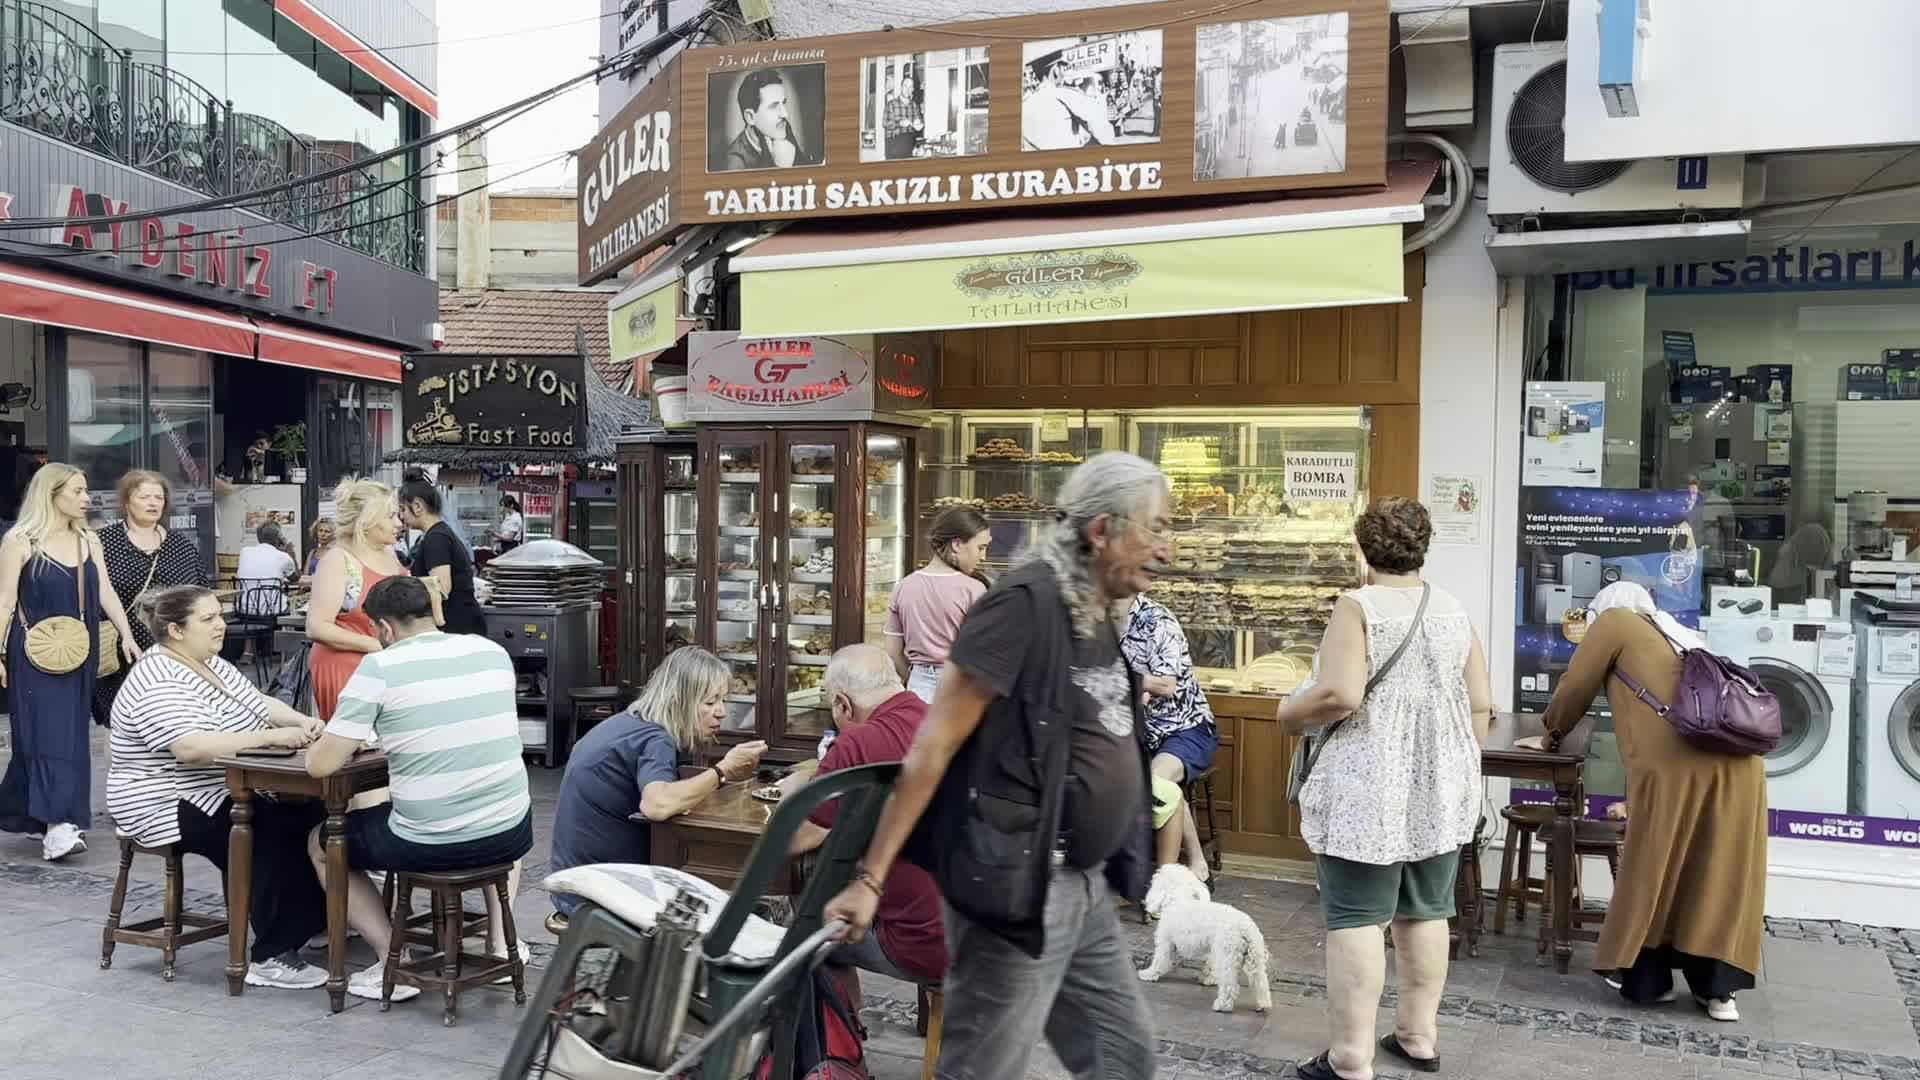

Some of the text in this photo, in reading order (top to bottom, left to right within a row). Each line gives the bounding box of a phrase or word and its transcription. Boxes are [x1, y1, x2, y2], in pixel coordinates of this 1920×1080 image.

[741, 51, 761, 67] yıl
[583, 110, 672, 227] GÜLER
[704, 158, 1162, 215] TARİHİ SAKIZLI KURABİYE
[588, 185, 671, 273] TATLIHANESİ
[62, 186, 337, 312] AYDENİZ ET
[1005, 266, 1085, 285] GÜLER
[744, 338, 815, 357] GÜLER
[449, 359, 577, 406] İSTASYON
[468, 423, 574, 445] Fast Food
[1286, 457, 1353, 467] KARADUTLU
[1293, 471, 1345, 484] BOMBA
[1290, 487, 1347, 499] ÇIKMIŞTIR
[1526, 513, 1604, 523] Yeni evlenenlere
[1526, 523, 1549, 531] evini
[1550, 524, 1614, 533] yenileyenlere
[1616, 525, 1637, 535] yeni
[1638, 526, 1651, 535] yıl
[1788, 822, 1865, 839] WORLD
[1883, 830, 1920, 843] WO
